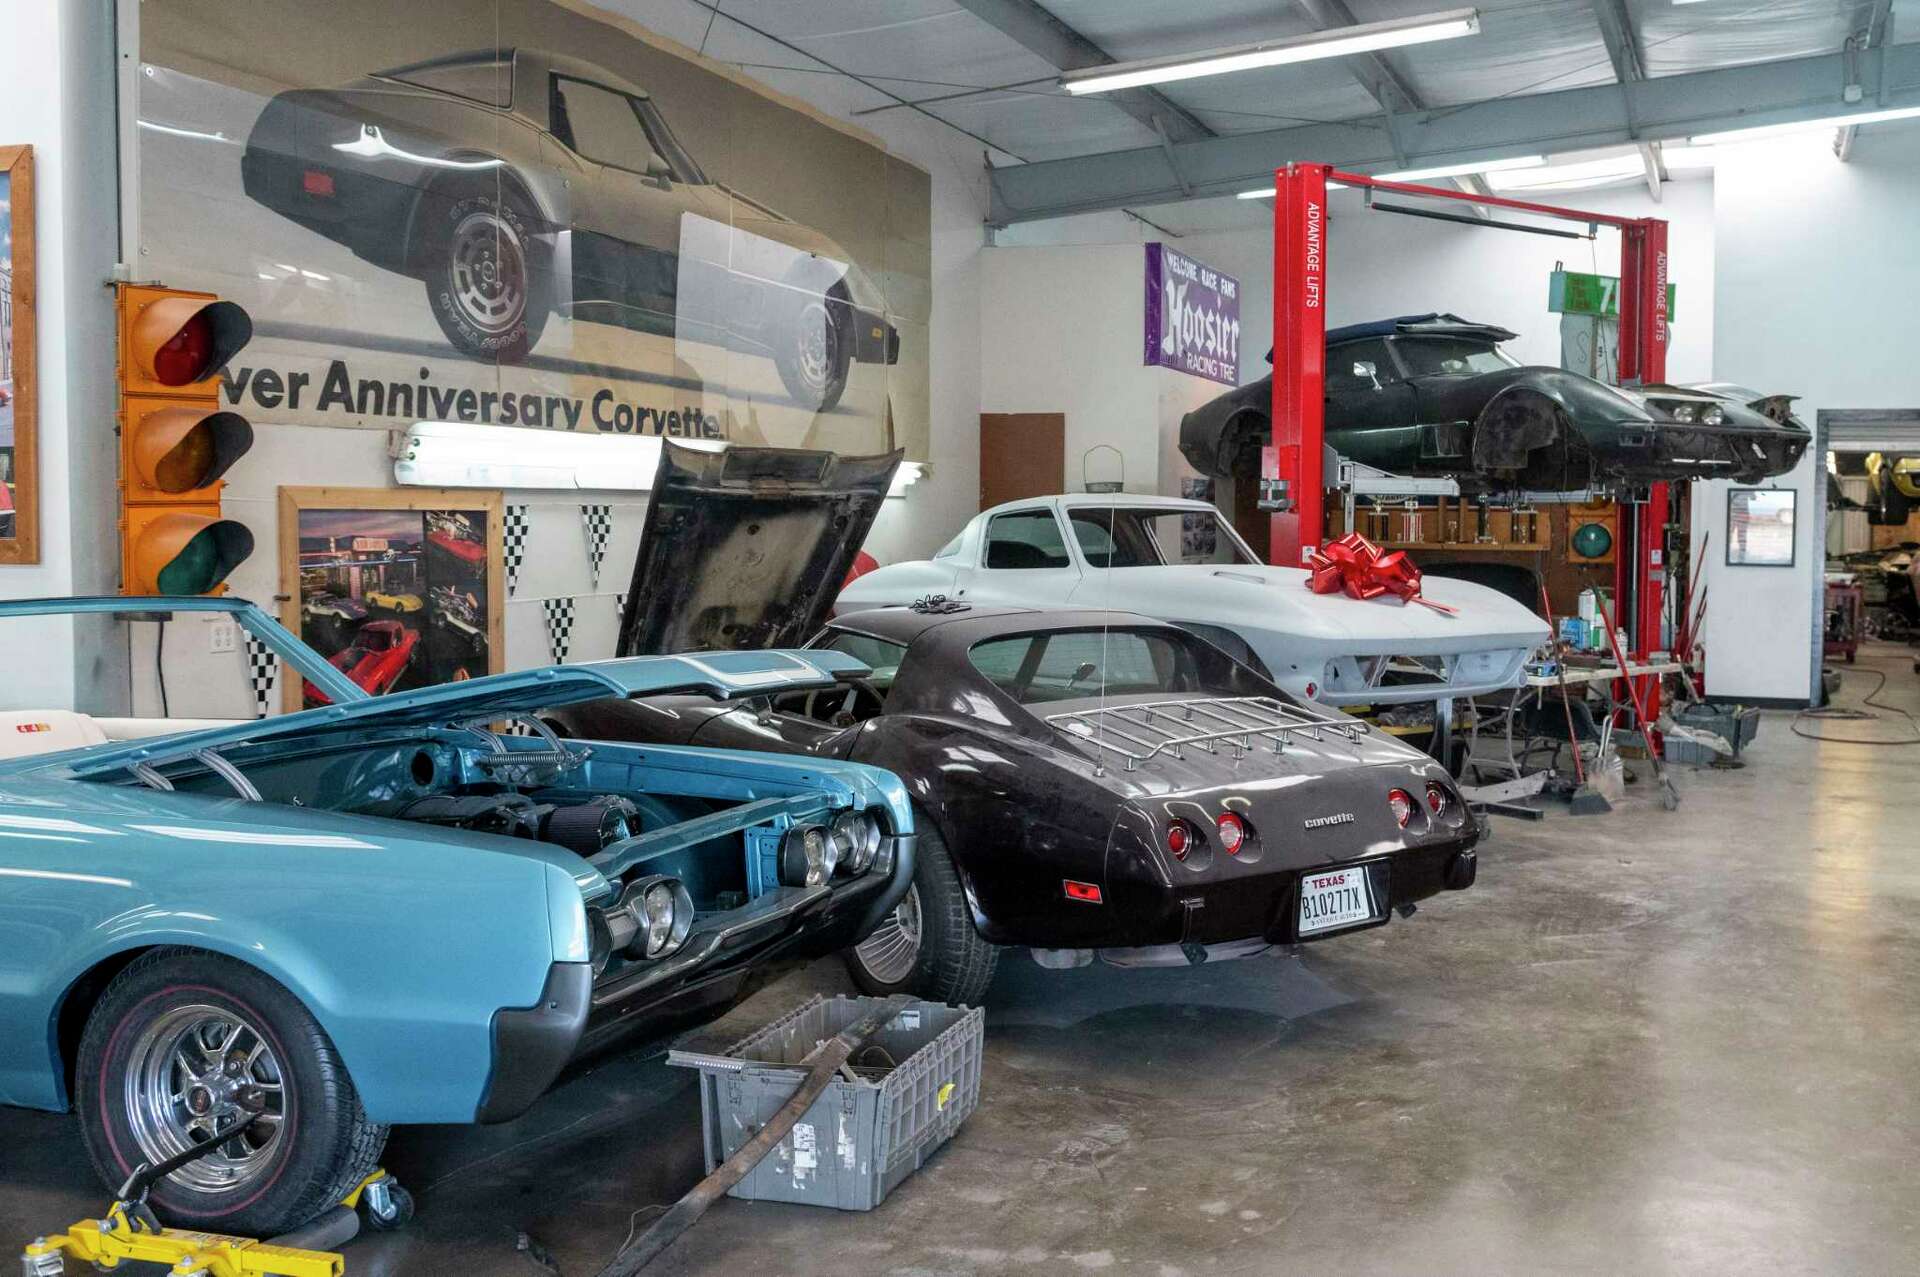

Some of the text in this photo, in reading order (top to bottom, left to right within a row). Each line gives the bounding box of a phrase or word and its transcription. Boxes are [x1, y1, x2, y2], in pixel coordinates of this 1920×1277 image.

[1166, 251, 1236, 299] WELCOME RACE FANS
[1306, 202, 1320, 308] ADVANTAGE LIFTS
[1162, 278, 1240, 362] Hoosier
[1656, 251, 1666, 341] ADVANTAGE LIFTS
[1186, 351, 1218, 376] RACING
[223, 364, 310, 410] ver
[316, 359, 583, 430] Anniversary
[1302, 887, 1361, 919] B10277X
[1312, 874, 1345, 889] TEXAS
